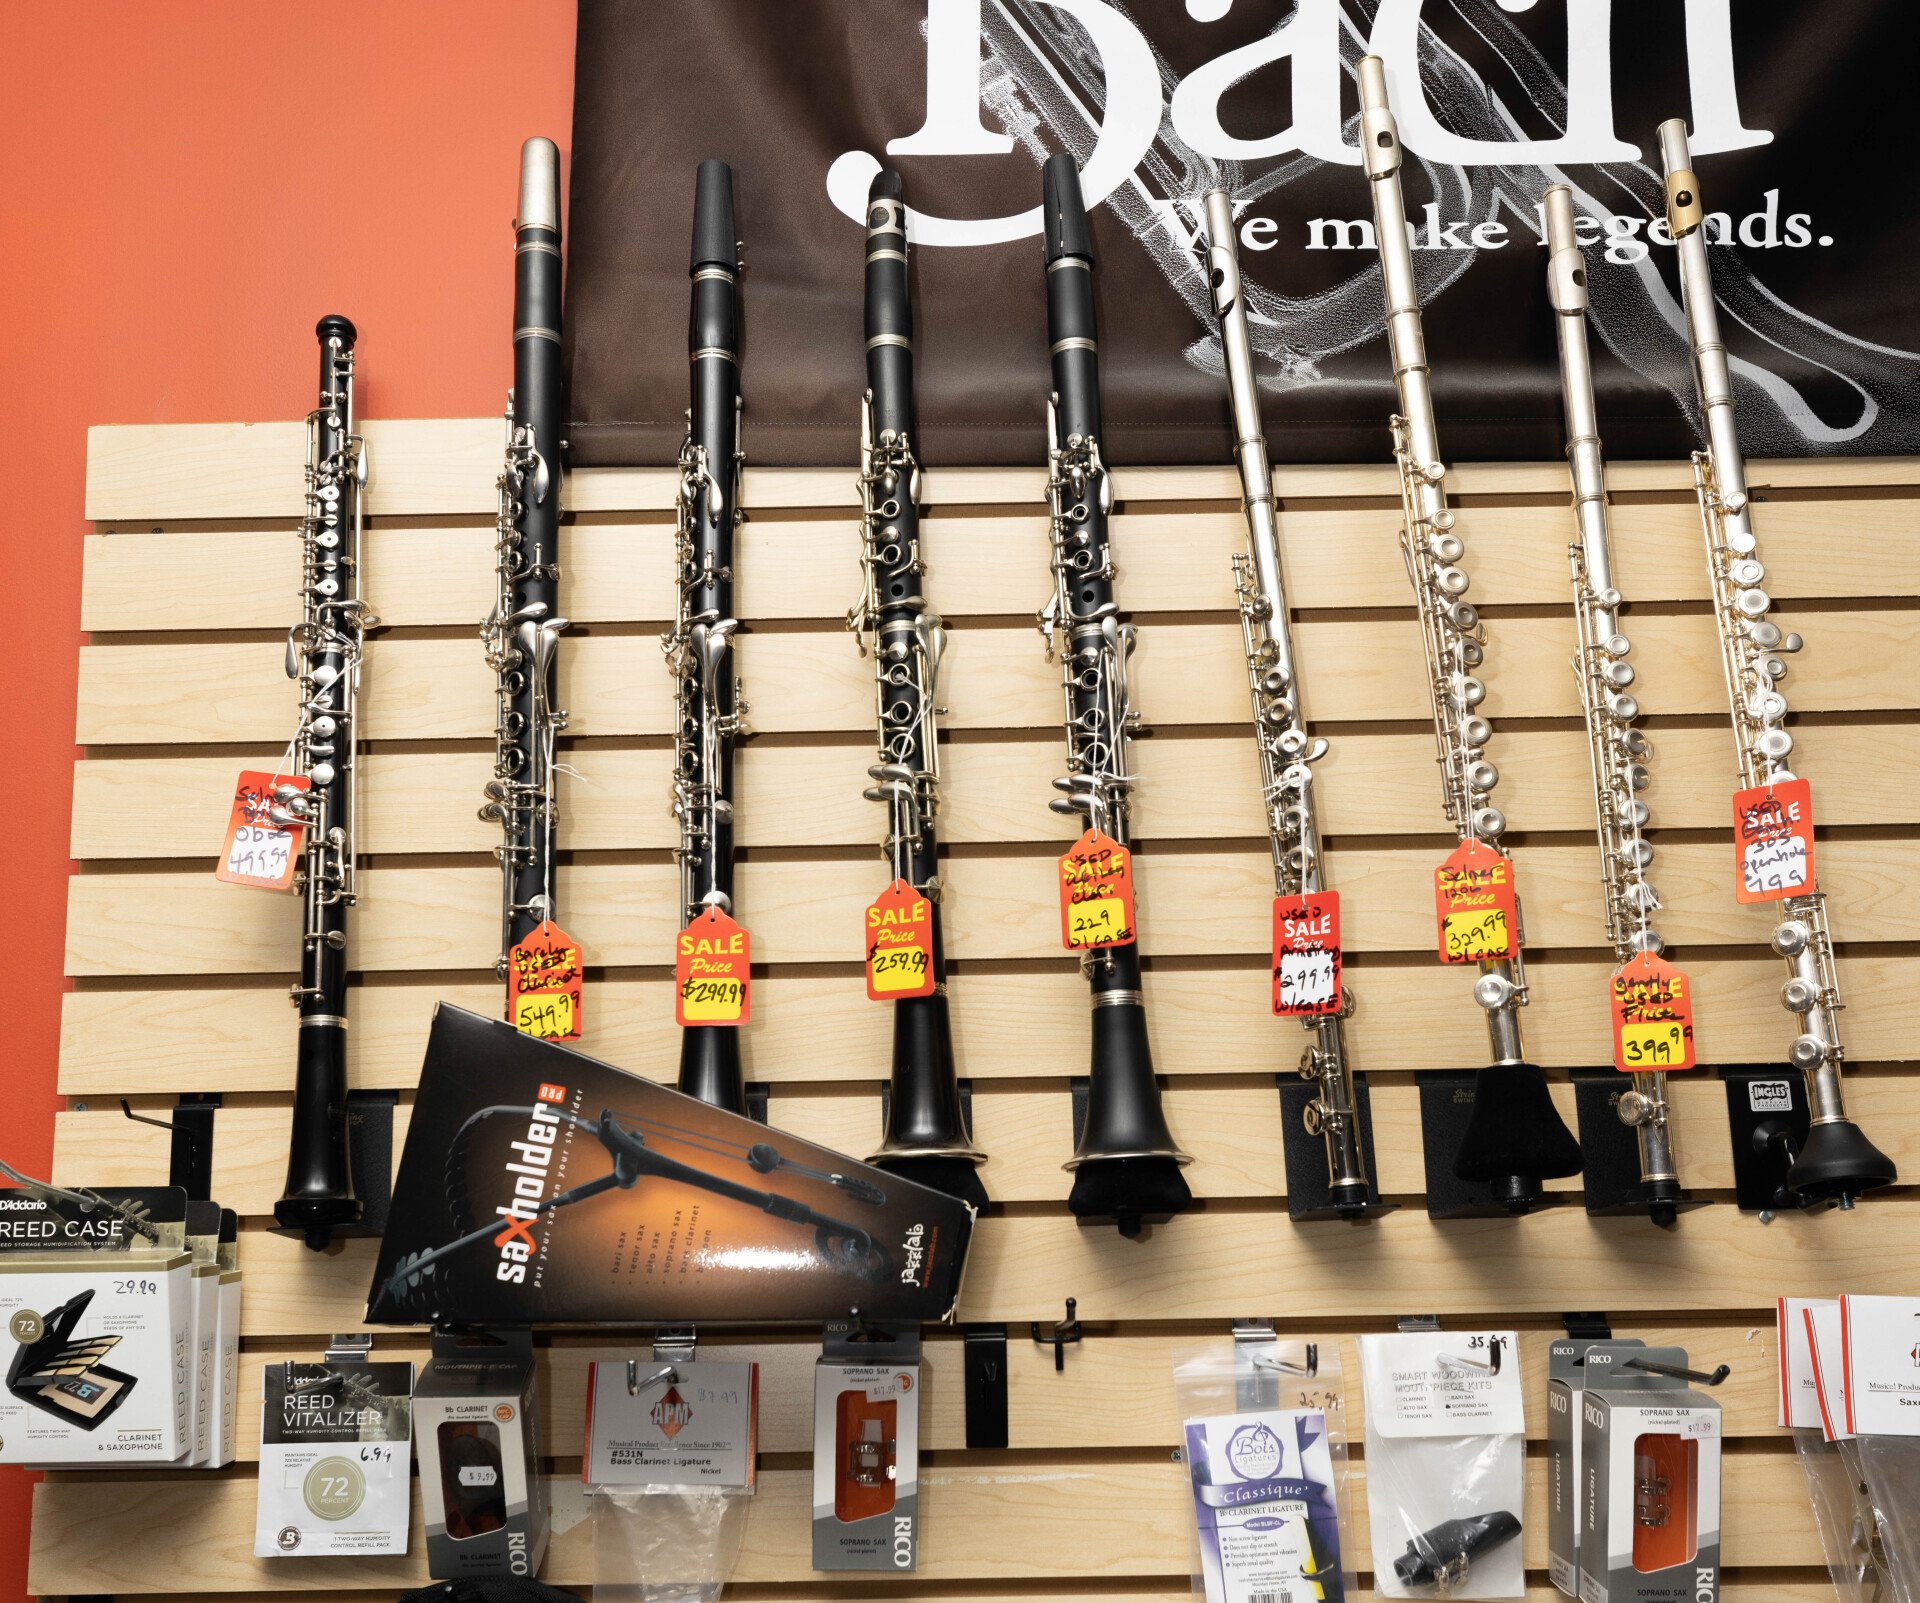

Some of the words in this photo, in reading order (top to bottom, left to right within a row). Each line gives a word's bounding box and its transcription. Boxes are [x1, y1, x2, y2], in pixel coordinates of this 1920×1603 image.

[1305, 202, 1510, 252] mke
[1450, 892, 1495, 908] Price
[868, 900, 925, 927] SALE
[1074, 909, 1110, 931] 229
[877, 928, 915, 945] Price
[1284, 913, 1331, 938] SALE
[680, 933, 744, 955] SALE
[689, 957, 733, 974] Price
[867, 941, 929, 974] $259.99
[680, 976, 747, 1007] $299.99
[520, 990, 580, 1029] 549.99
[1753, 1085, 1787, 1099] INGLES
[494, 1102, 560, 1283] saxholder
[541, 1086, 563, 1101] PRO
[534, 1265, 544, 1288] put
[540, 1231, 551, 1261] your
[547, 1205, 556, 1225] sax
[552, 1184, 561, 1198] on
[557, 1150, 569, 1178] your
[565, 1088, 584, 1144] shoulder
[0, 1221, 57, 1238] REED
[64, 1220, 124, 1237] CASE
[685, 1205, 700, 1247] clarinet
[611, 1252, 622, 1274] bari
[617, 1231, 627, 1249] sax
[629, 1245, 640, 1274] tenor
[637, 1224, 645, 1241] sax
[663, 1231, 677, 1273] soprano
[673, 1210, 682, 1227] sax
[646, 1253, 656, 1274] alto
[652, 1232, 660, 1249] sax
[18, 1320, 36, 1332] 72
[827, 1323, 848, 1332] RICO
[175, 1332, 186, 1384] CASE
[1553, 1347, 1574, 1355] RICO
[1589, 1354, 1612, 1363] RICO
[201, 1340, 209, 1391] CASE
[224, 1345, 233, 1396] CASE
[1392, 1371, 1427, 1382] SMART
[1432, 1369, 1493, 1380] WOODWIN
[1468, 1381, 1493, 1390] KITS
[284, 1394, 335, 1410] REED
[456, 1405, 488, 1413] CLARINET
[1550, 1393, 1567, 1414] RICO
[178, 1391, 187, 1445] REED
[283, 1411, 382, 1427] VITALIZER
[652, 1402, 689, 1425] APM
[1585, 1402, 1604, 1429] RICO
[197, 1399, 207, 1451] REED
[223, 1403, 232, 1452] REED
[106, 1443, 163, 1451] SAXOPHONE
[117, 1433, 163, 1442] CLARINET
[608, 1440, 633, 1448] Musical
[634, 1440, 659, 1448] Product
[1236, 1436, 1276, 1455] Bois
[610, 1457, 632, 1465] Bass
[634, 1457, 670, 1465] Clarinet
[673, 1458, 711, 1467] Ligature
[611, 1450, 643, 1458] #531N
[1234, 1454, 1277, 1464] Ligatures
[320, 1476, 349, 1497] 72
[1554, 1452, 1562, 1513] LIGATURE
[1228, 1506, 1267, 1517] CLARINET
[1268, 1503, 1305, 1514] LIGATURE
[840, 1538, 871, 1546] SOPRANO
[873, 1538, 887, 1546] SAX
[894, 1516, 912, 1568] RICO
[507, 1532, 528, 1576] RICO
[1696, 1567, 1714, 1603] RIC
